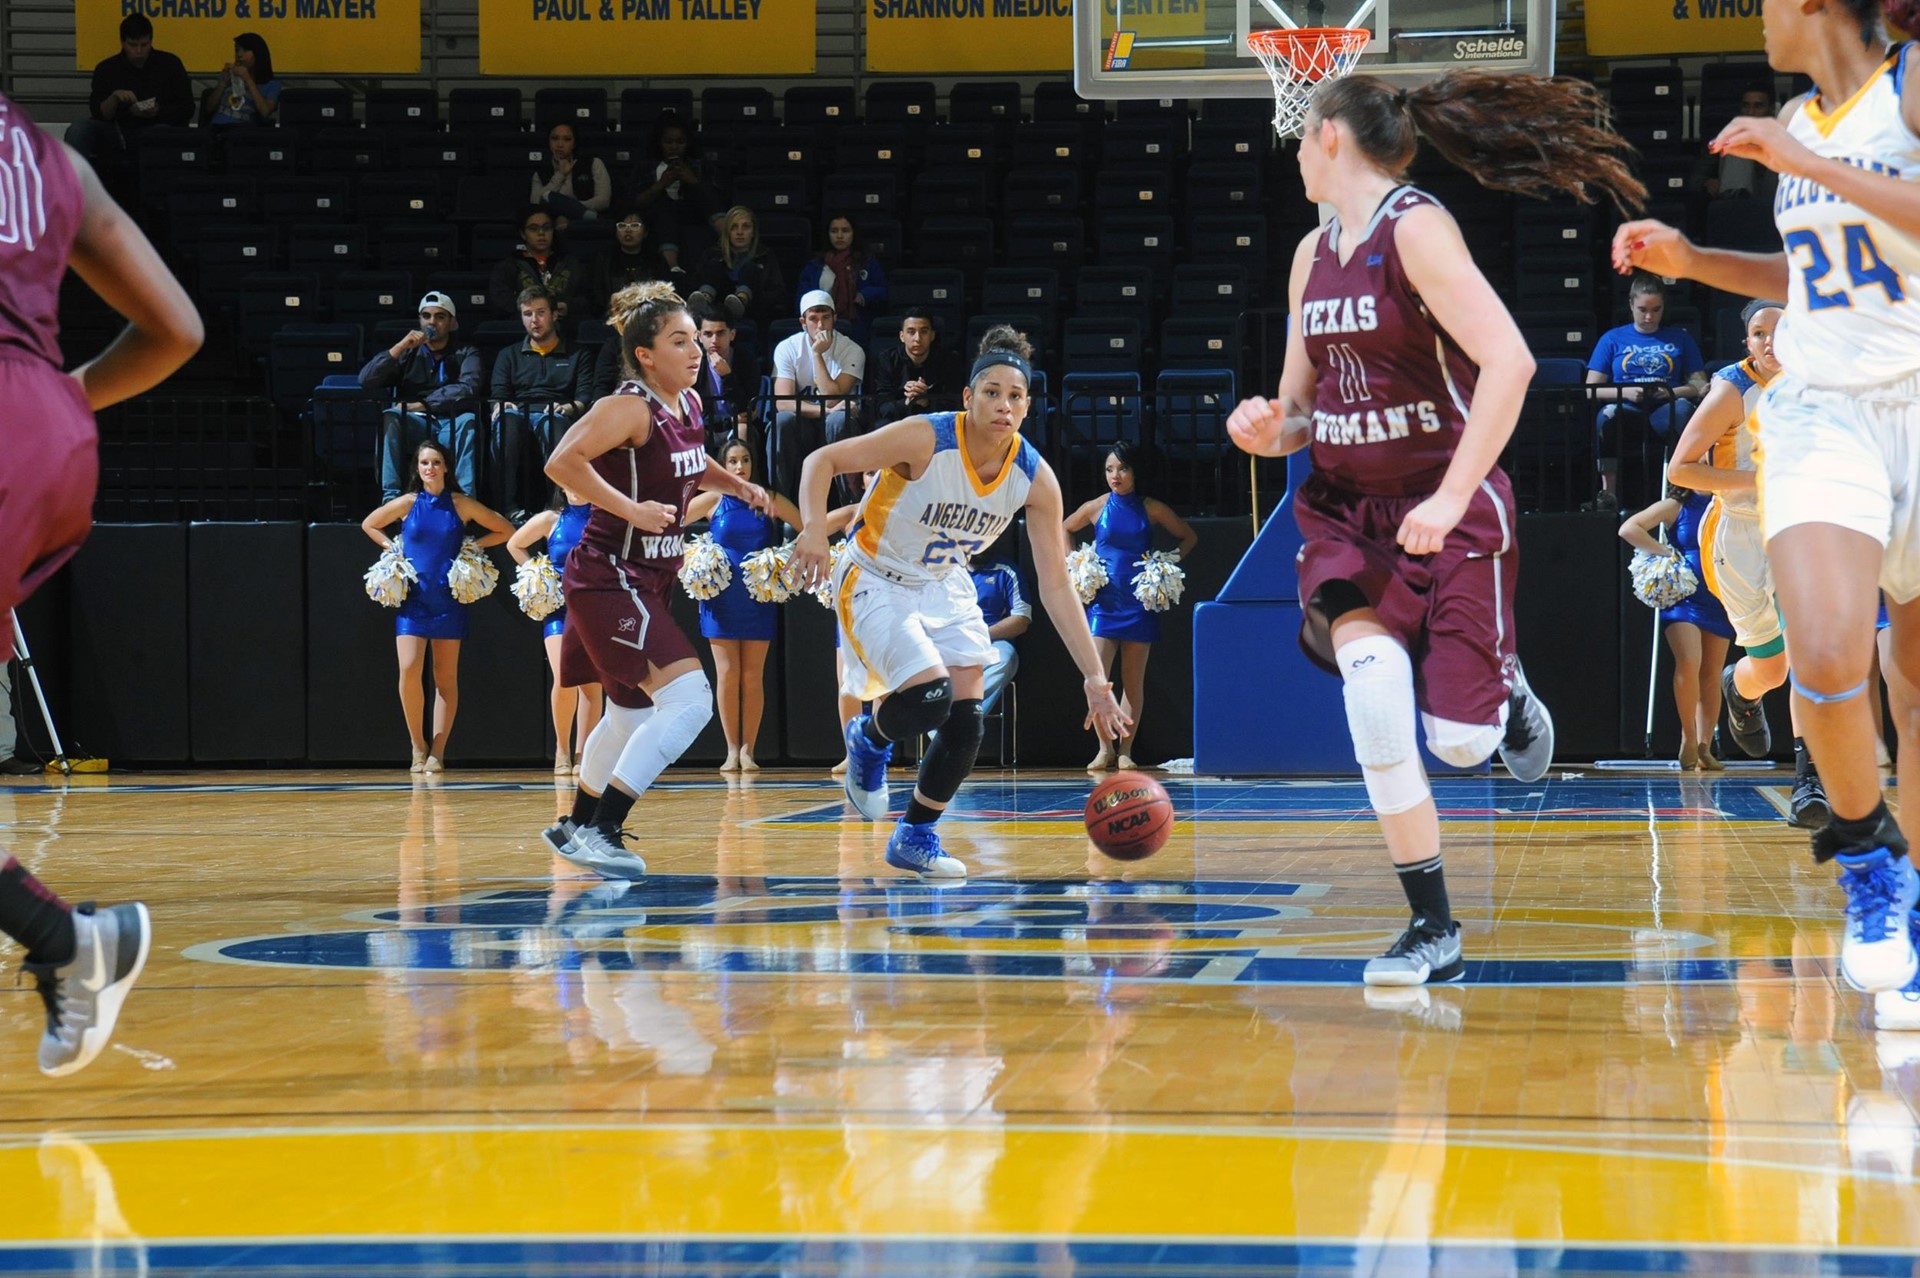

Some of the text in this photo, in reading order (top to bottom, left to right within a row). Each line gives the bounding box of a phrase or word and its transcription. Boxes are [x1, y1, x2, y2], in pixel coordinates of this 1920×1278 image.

[121, 0, 376, 18] RICHARD & BJ MAYER
[533, 0, 760, 20] PAUL & PAM TALLEY
[873, 0, 1199, 18] SHANNON MEDIC CENTER
[1673, 0, 1690, 19] &
[1453, 38, 1524, 59] Schelde
[1784, 221, 1908, 312] 24
[1302, 295, 1378, 337] TEXAS
[1327, 343, 1371, 403] 11
[1311, 400, 1441, 445] WOMAN'S
[670, 443, 707, 478] TEXA
[919, 502, 979, 532] ANGELO
[641, 533, 684, 559] WOM
[1093, 788, 1149, 815] Wilson
[1108, 810, 1151, 835] NCAA
